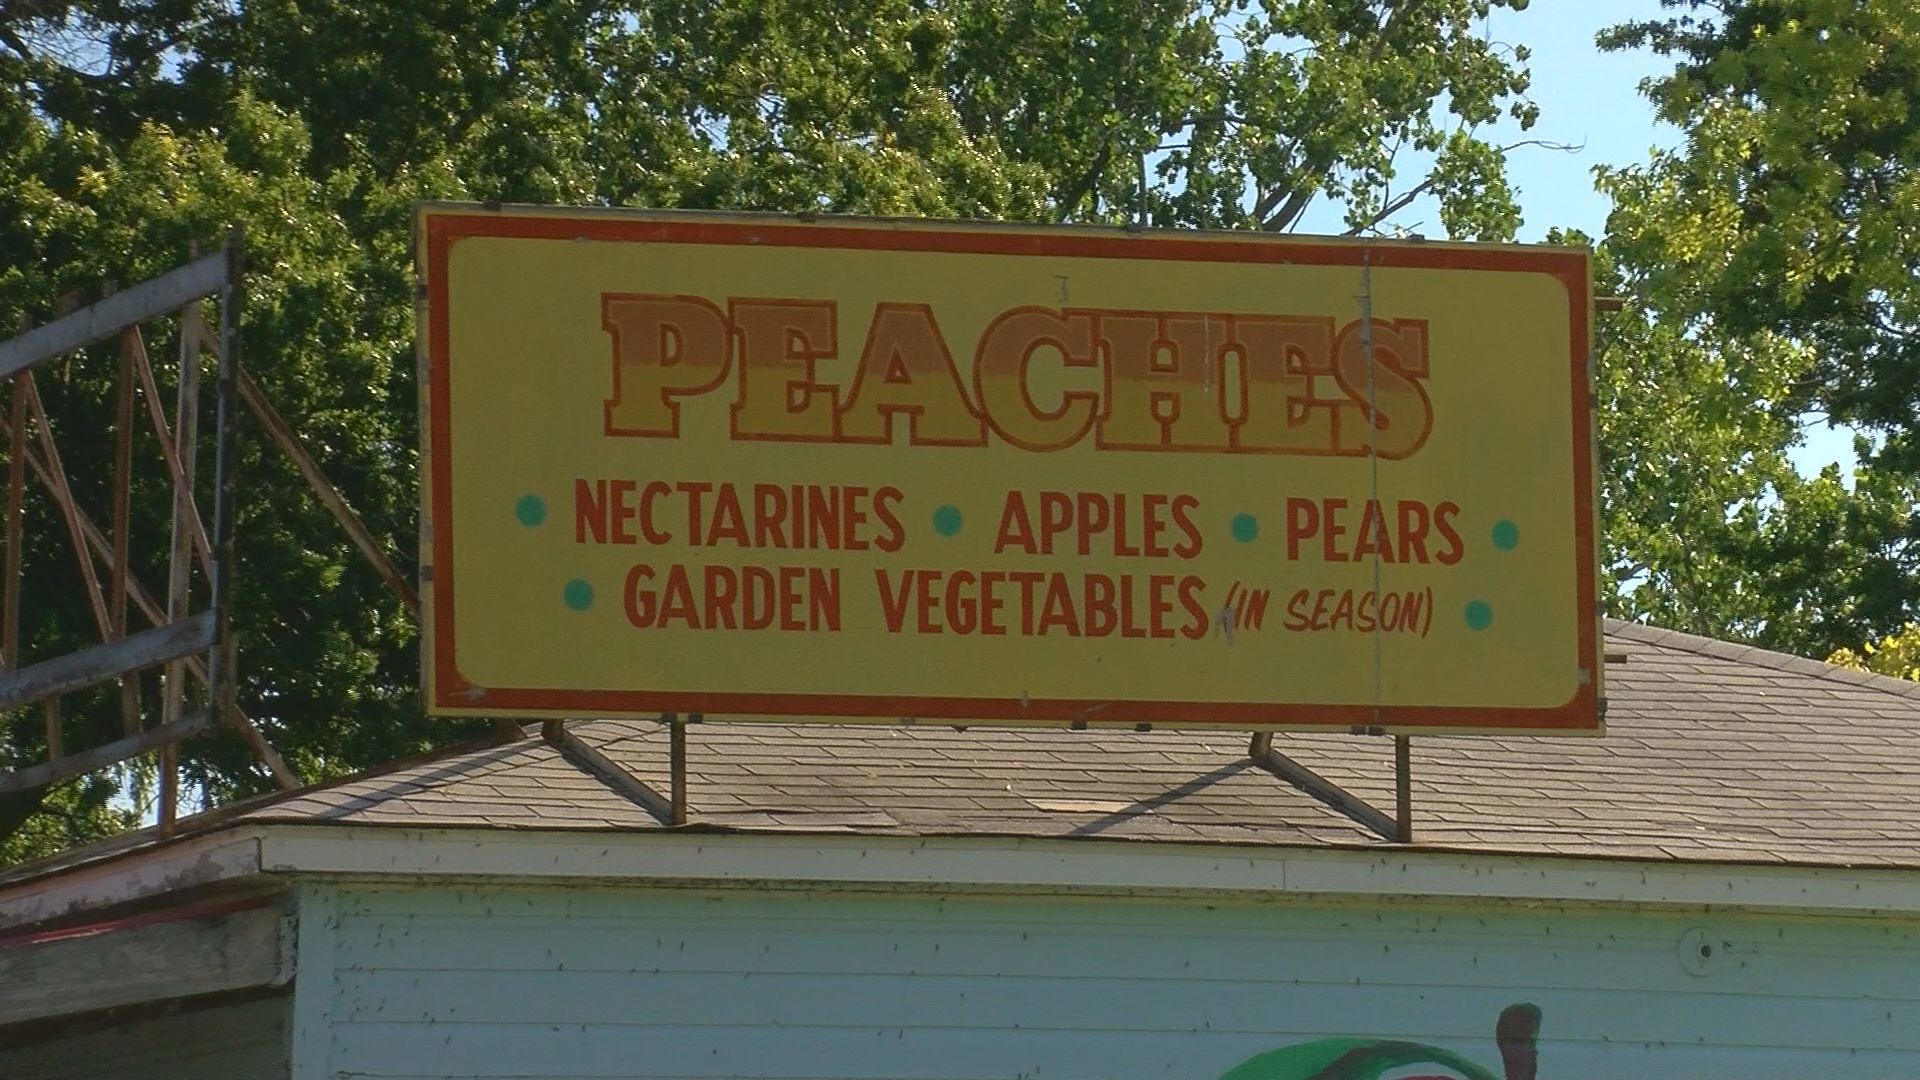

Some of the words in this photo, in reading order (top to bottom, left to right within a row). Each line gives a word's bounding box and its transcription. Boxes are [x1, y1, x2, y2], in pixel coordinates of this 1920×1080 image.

[601, 292, 1433, 460] PEACHES
[574, 478, 906, 552] NECTARINES
[993, 490, 1203, 560] APPLES
[1286, 497, 1464, 566] PEARS
[623, 564, 841, 632] GARDEN
[875, 568, 1209, 640] VEGETABLES
[1222, 580, 1271, 633] (IN
[1283, 586, 1433, 639] SEASON)
